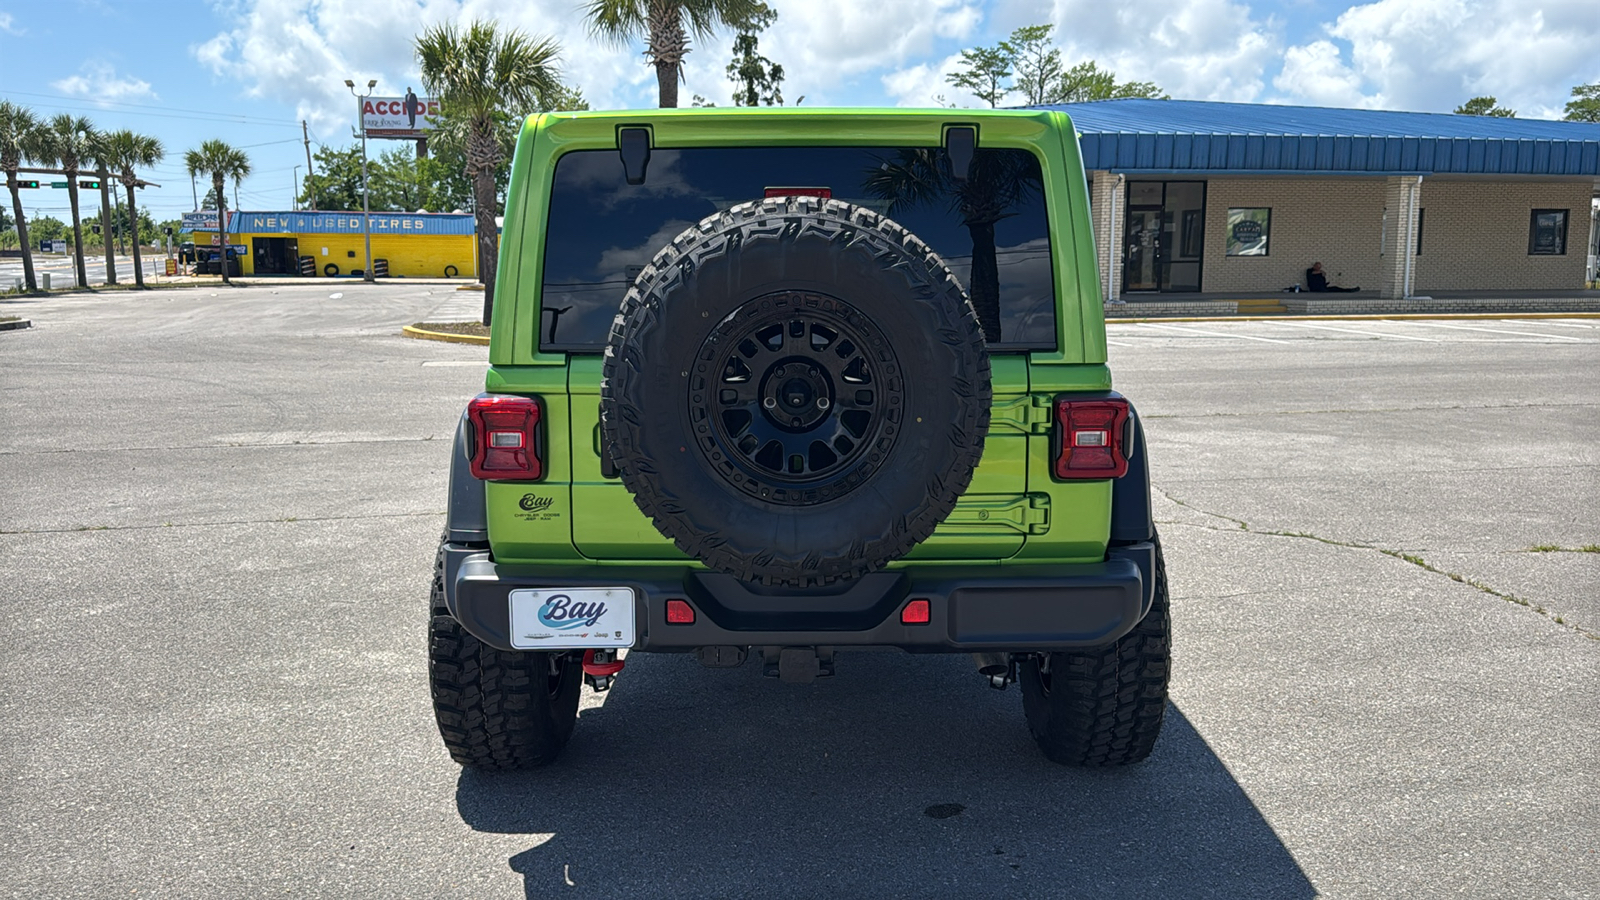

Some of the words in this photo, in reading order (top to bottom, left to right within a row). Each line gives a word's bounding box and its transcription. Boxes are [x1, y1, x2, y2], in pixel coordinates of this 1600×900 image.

[253, 217, 289, 228] NEW
[312, 218, 360, 228] USED
[367, 218, 424, 229] TIRES
[519, 493, 554, 511] Bay
[543, 594, 608, 627] Bay
